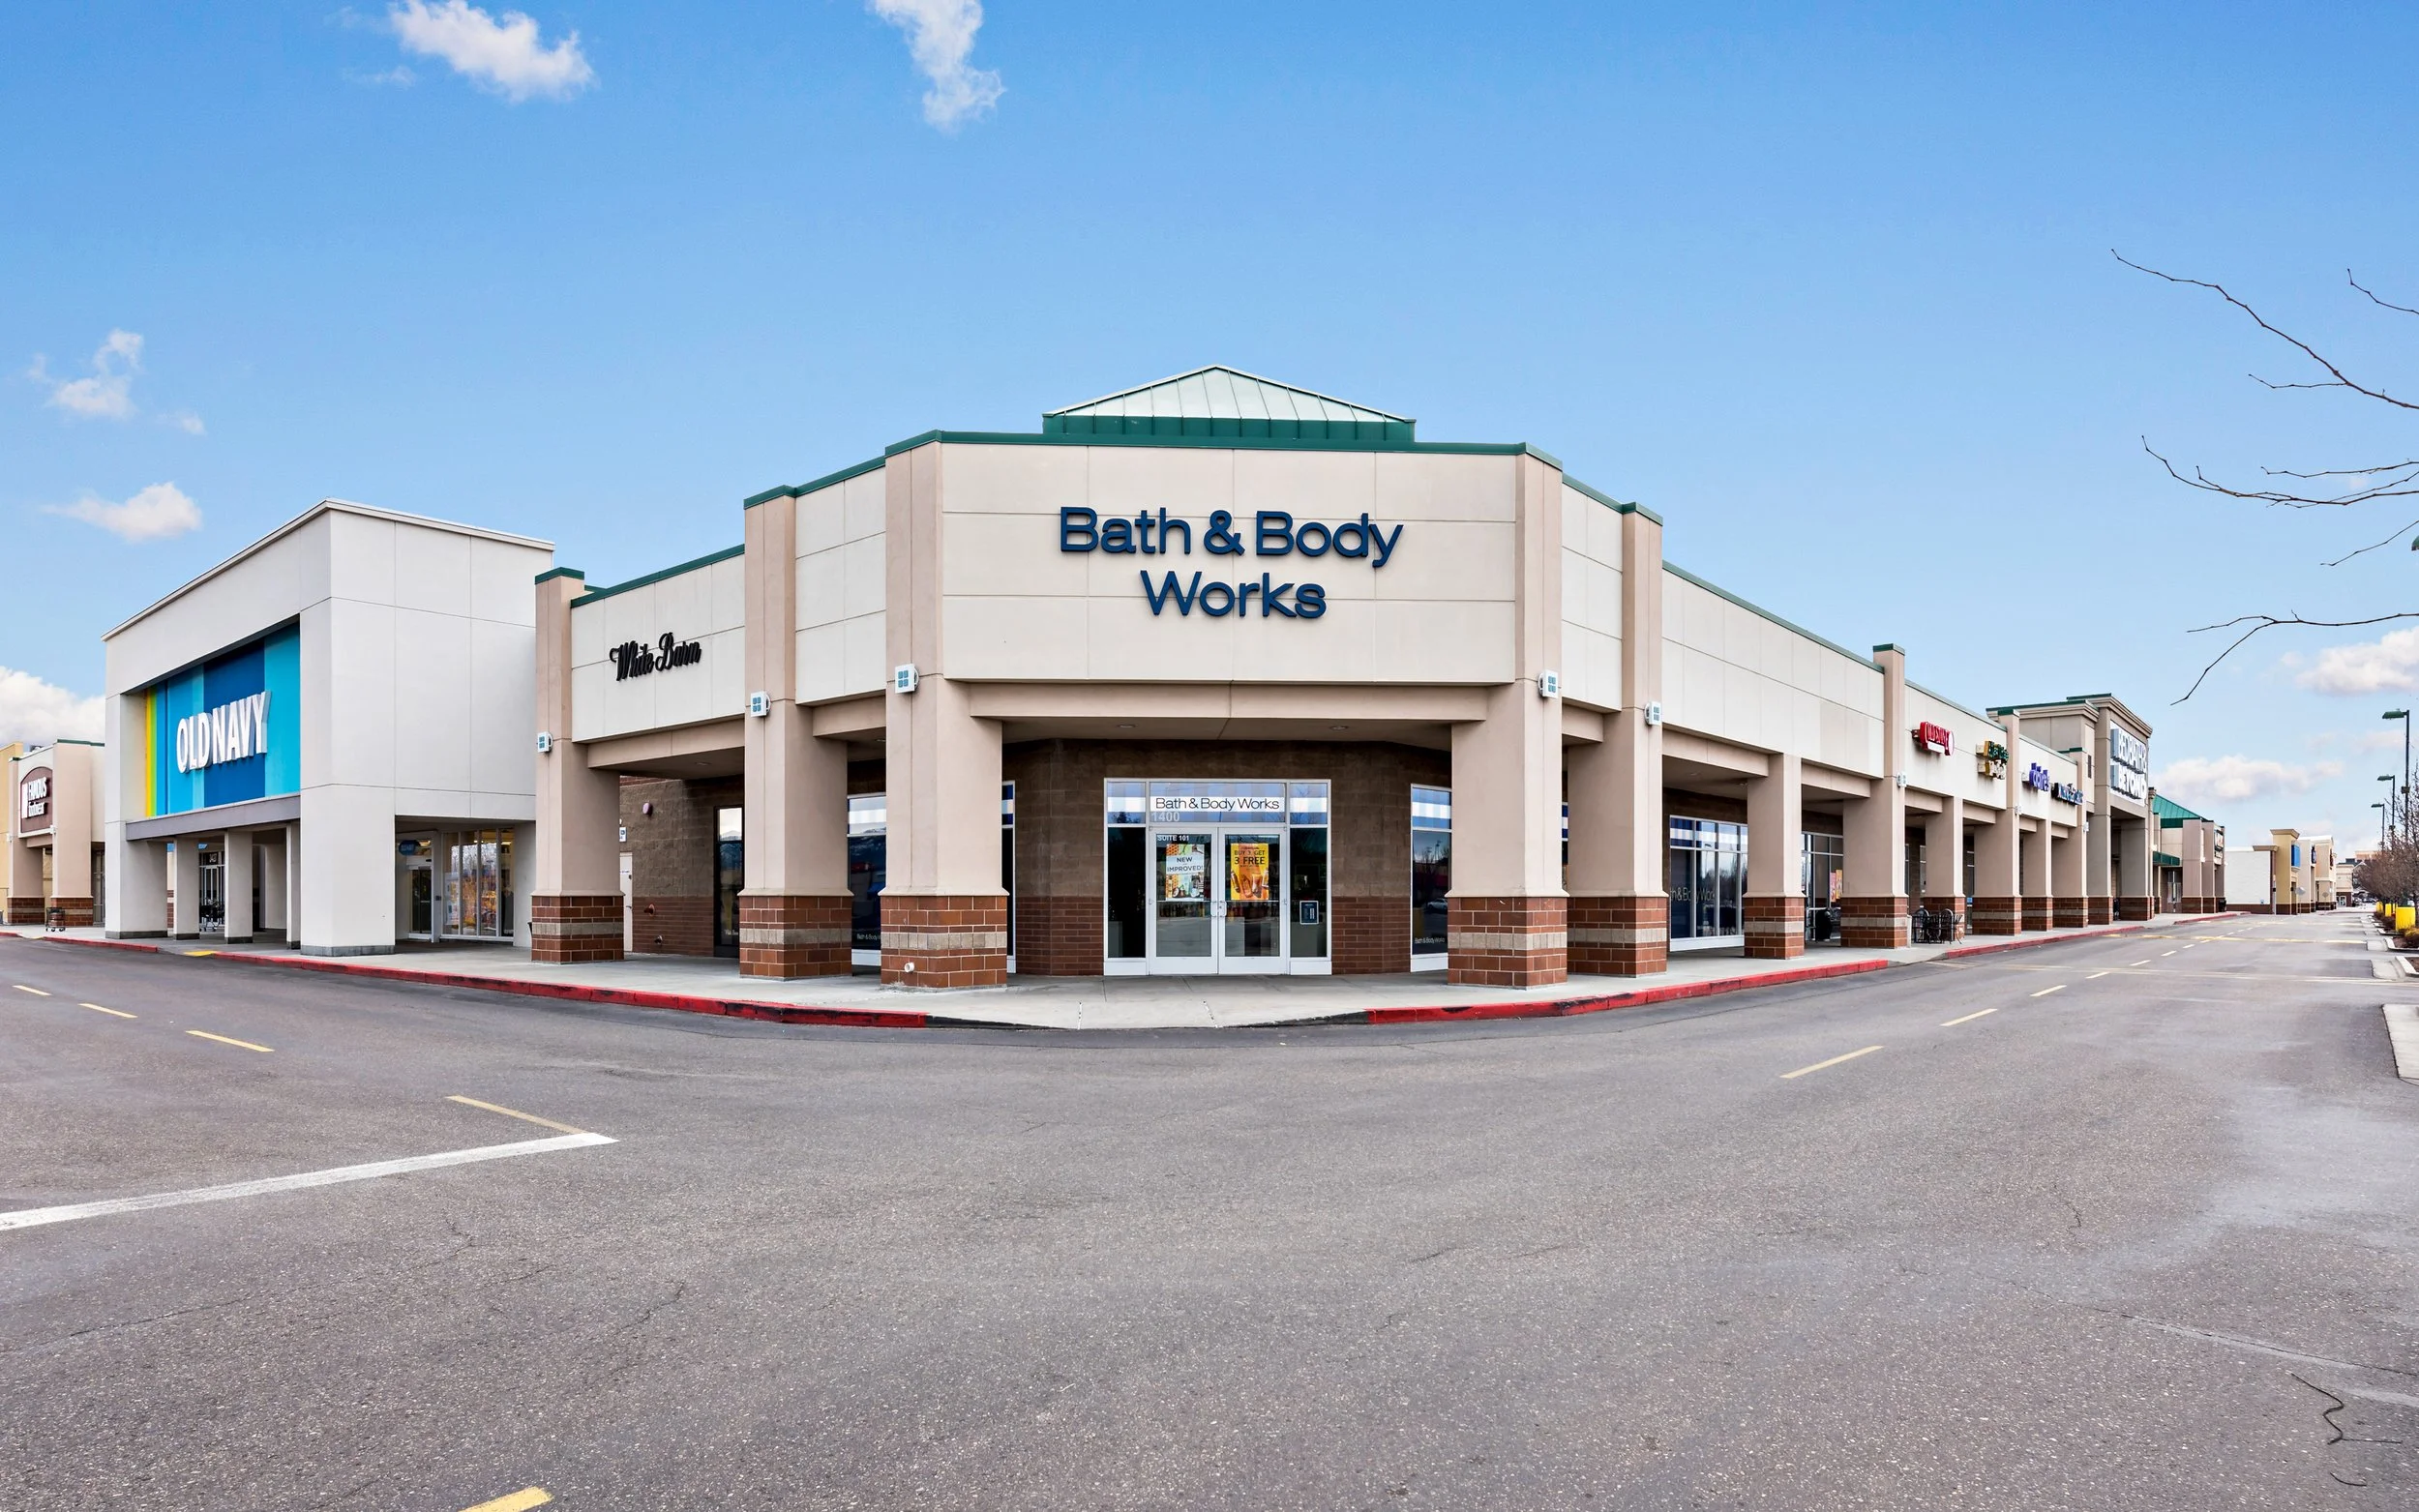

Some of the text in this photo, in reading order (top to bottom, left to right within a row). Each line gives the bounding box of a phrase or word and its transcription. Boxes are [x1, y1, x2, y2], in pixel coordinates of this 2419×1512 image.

[1060, 507, 1404, 568] Bath & Body
[1140, 570, 1327, 619] Works
[610, 632, 702, 681] White Barn
[176, 691, 271, 773] OLD NAVY
[1152, 812, 1180, 821] 1400
[1156, 797, 1280, 811] Bath & Body Works
